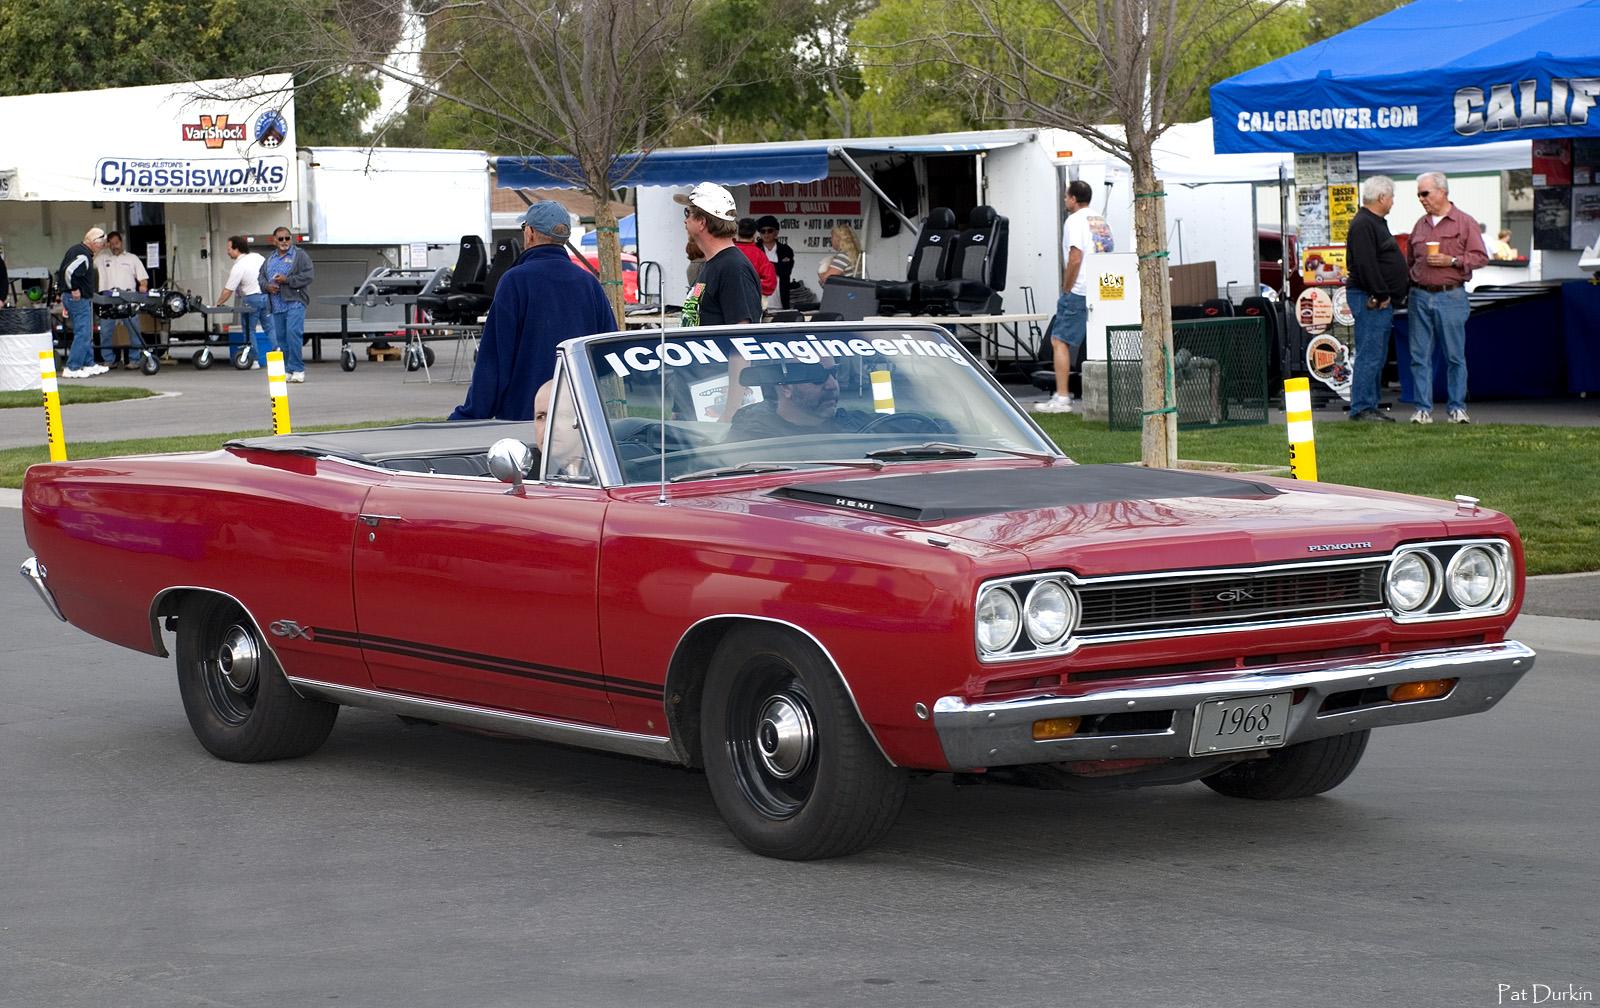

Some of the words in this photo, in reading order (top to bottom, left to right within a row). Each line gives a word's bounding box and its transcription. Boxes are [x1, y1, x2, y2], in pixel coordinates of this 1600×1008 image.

[1237, 105, 1418, 133] CALCARCOVER.COM
[185, 124, 243, 140] VariShock
[131, 161, 150, 169] CHRIS
[100, 160, 284, 187] Chassisworks
[784, 201, 798, 213] TOP
[800, 201, 830, 214] QUALITY
[604, 339, 729, 377] ICON
[732, 334, 970, 367] Engineering
[835, 498, 874, 510] HEMI
[1308, 541, 1372, 553] PLYMOUTH
[1216, 588, 1254, 602] GTX
[268, 619, 312, 640] GTX
[1216, 702, 1272, 736] 1968
